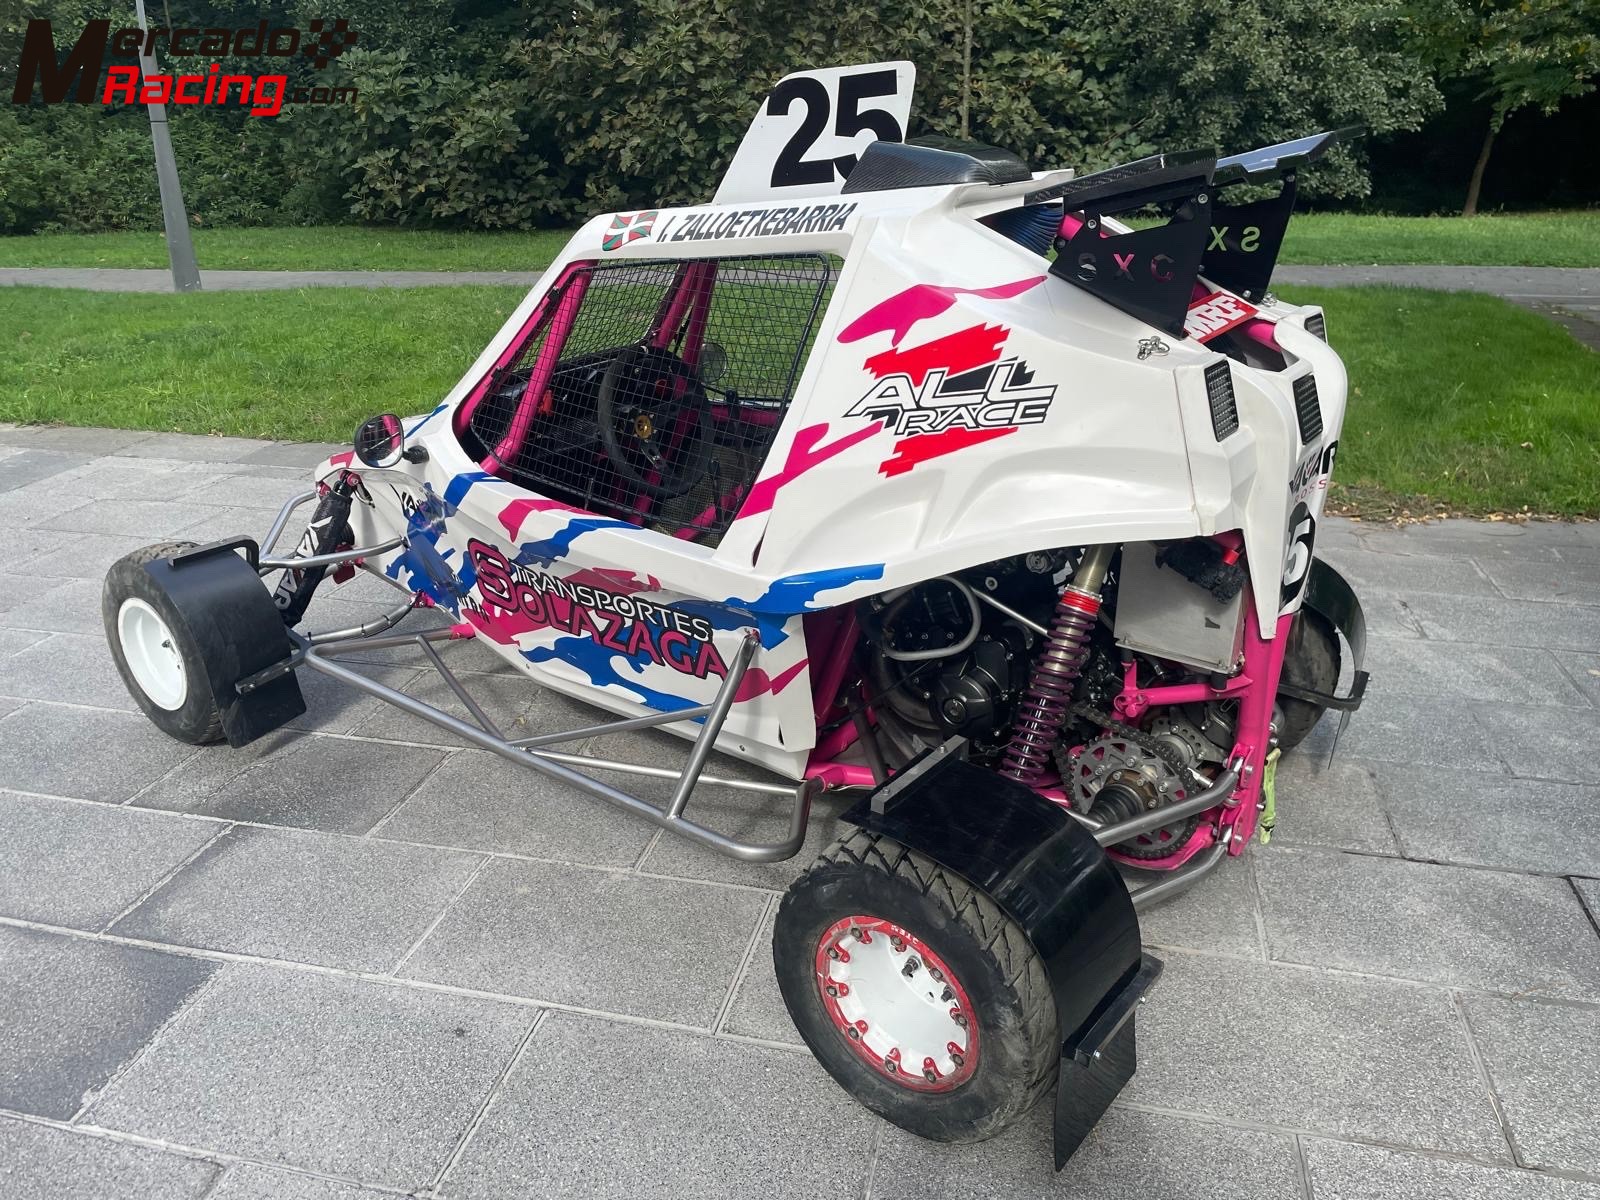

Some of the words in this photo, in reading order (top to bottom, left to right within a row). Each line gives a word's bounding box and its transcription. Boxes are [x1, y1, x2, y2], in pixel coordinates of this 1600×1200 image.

[766, 69, 903, 187] 25
[671, 202, 858, 242] ZALLOETXEBARRIA
[842, 361, 1058, 418] ALL
[894, 401, 1051, 436] RACE
[467, 537, 729, 681] SOLAZAGA
